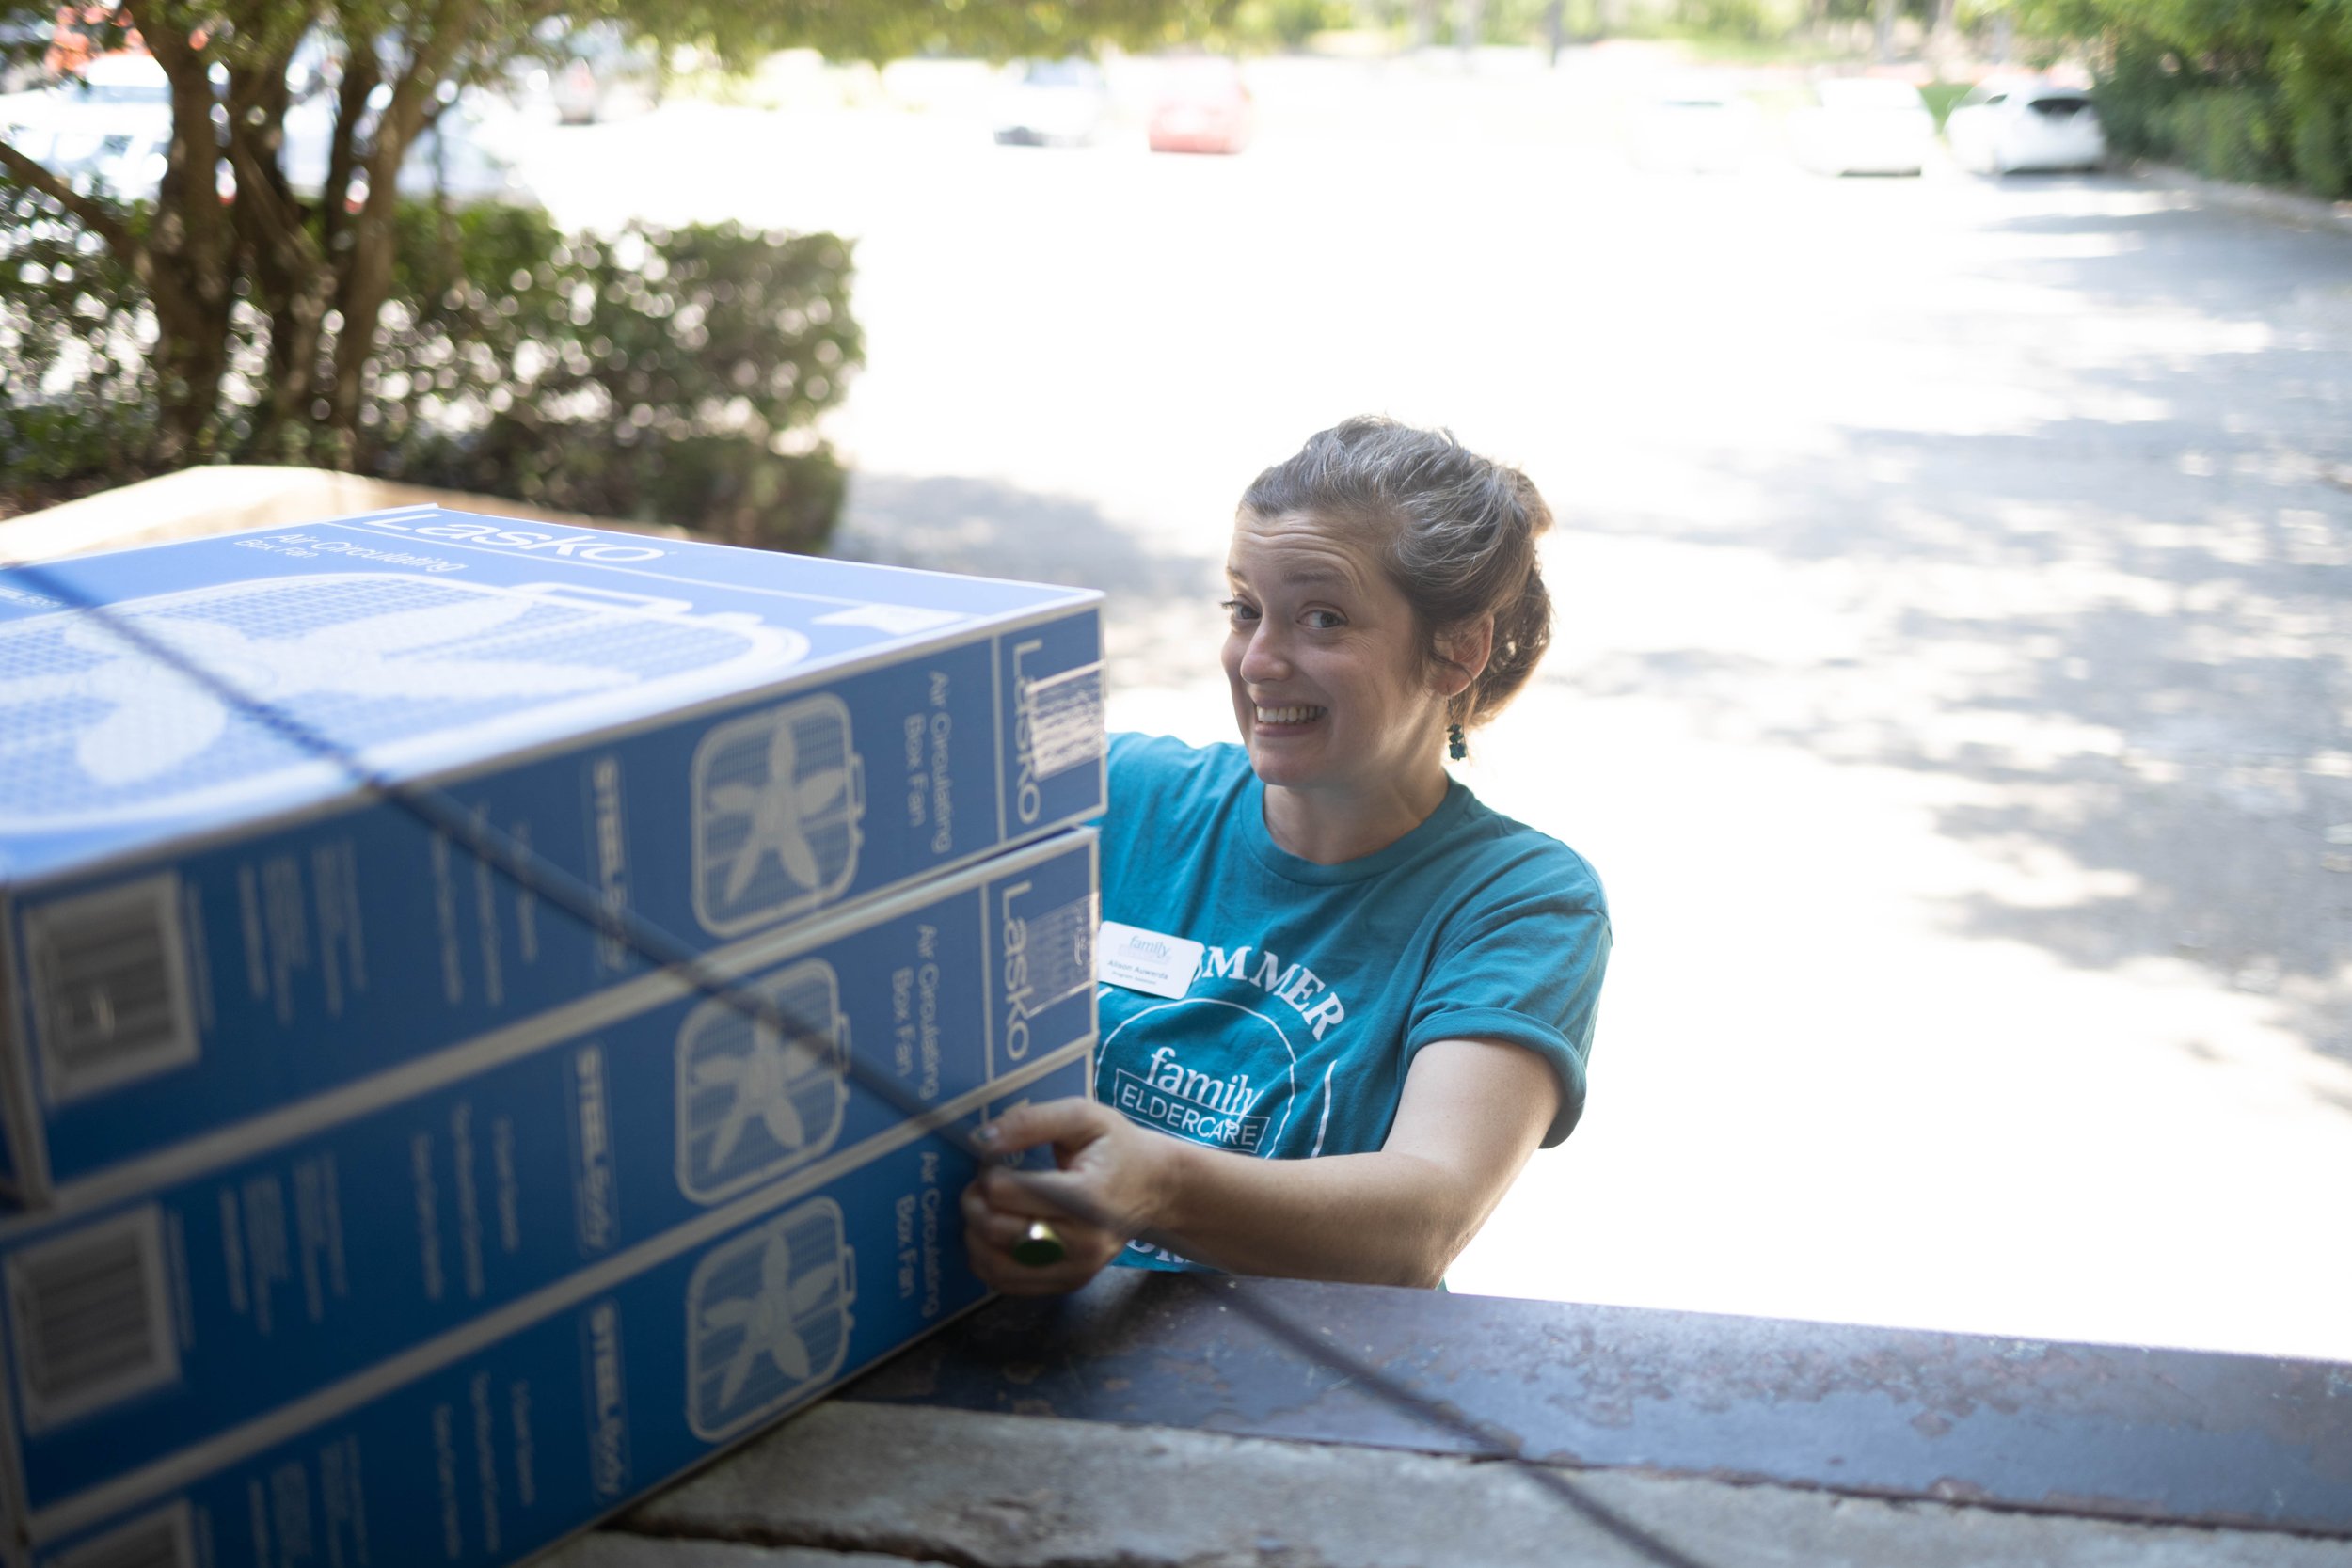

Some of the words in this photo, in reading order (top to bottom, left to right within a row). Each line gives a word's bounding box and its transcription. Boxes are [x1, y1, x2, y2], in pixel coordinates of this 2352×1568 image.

[311, 541, 469, 572] Circulating
[363, 513, 665, 562] Lasko
[929, 671, 949, 707] Air
[904, 713, 927, 767] Box
[1012, 639, 1043, 824] Lasko
[907, 773, 928, 826] Fan
[930, 712, 952, 853] Circulating
[918, 925, 938, 958] Air
[892, 967, 914, 1021] Box
[1002, 881, 1033, 1061] Lasko
[1193, 946, 1345, 1041] MMER
[895, 1023, 915, 1077] Fan
[918, 963, 940, 1100] Circulating
[1146, 1046, 1264, 1128] family
[1120, 1085, 1258, 1147] ELDERCARE
[896, 1194, 916, 1248] Box
[898, 1248, 918, 1298] Fan
[921, 1188, 939, 1317] Circulating
